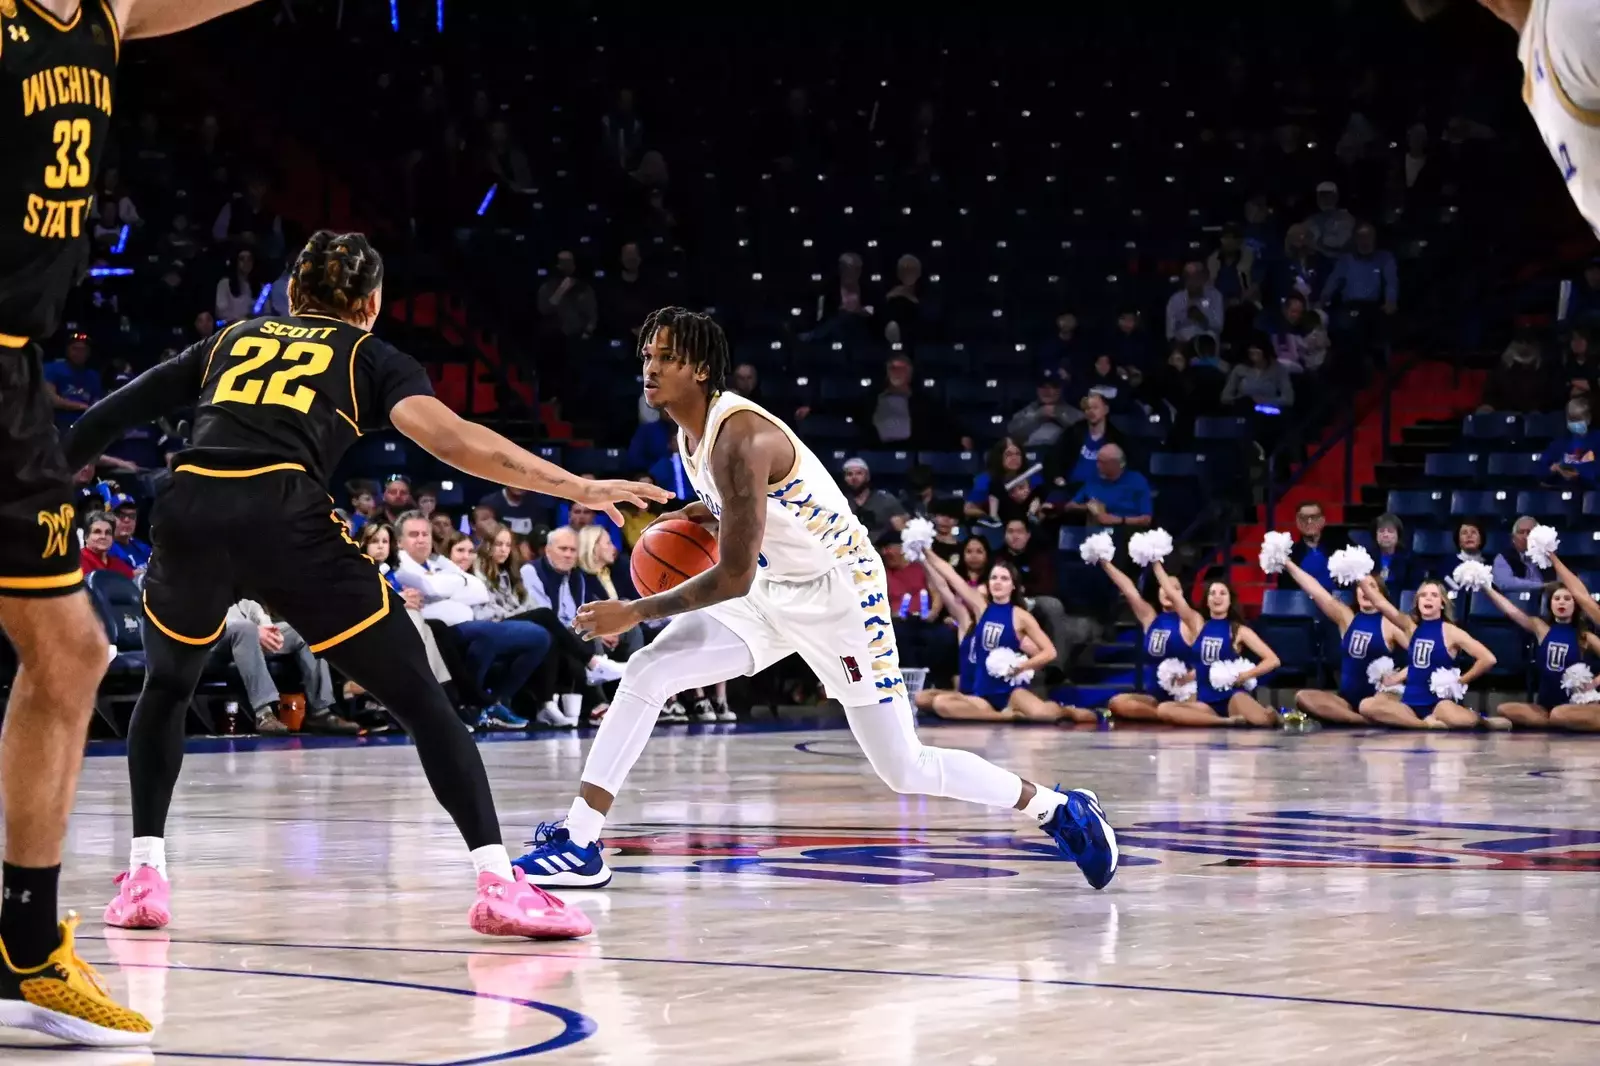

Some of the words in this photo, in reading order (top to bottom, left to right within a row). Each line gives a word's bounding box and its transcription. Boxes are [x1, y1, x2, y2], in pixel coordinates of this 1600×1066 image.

[22, 65, 112, 117] WICHITA
[44, 118, 91, 189] 33
[23, 193, 94, 238] STAT
[259, 320, 337, 339] SCOTT
[211, 336, 334, 414] 22
[38, 503, 75, 559] W
